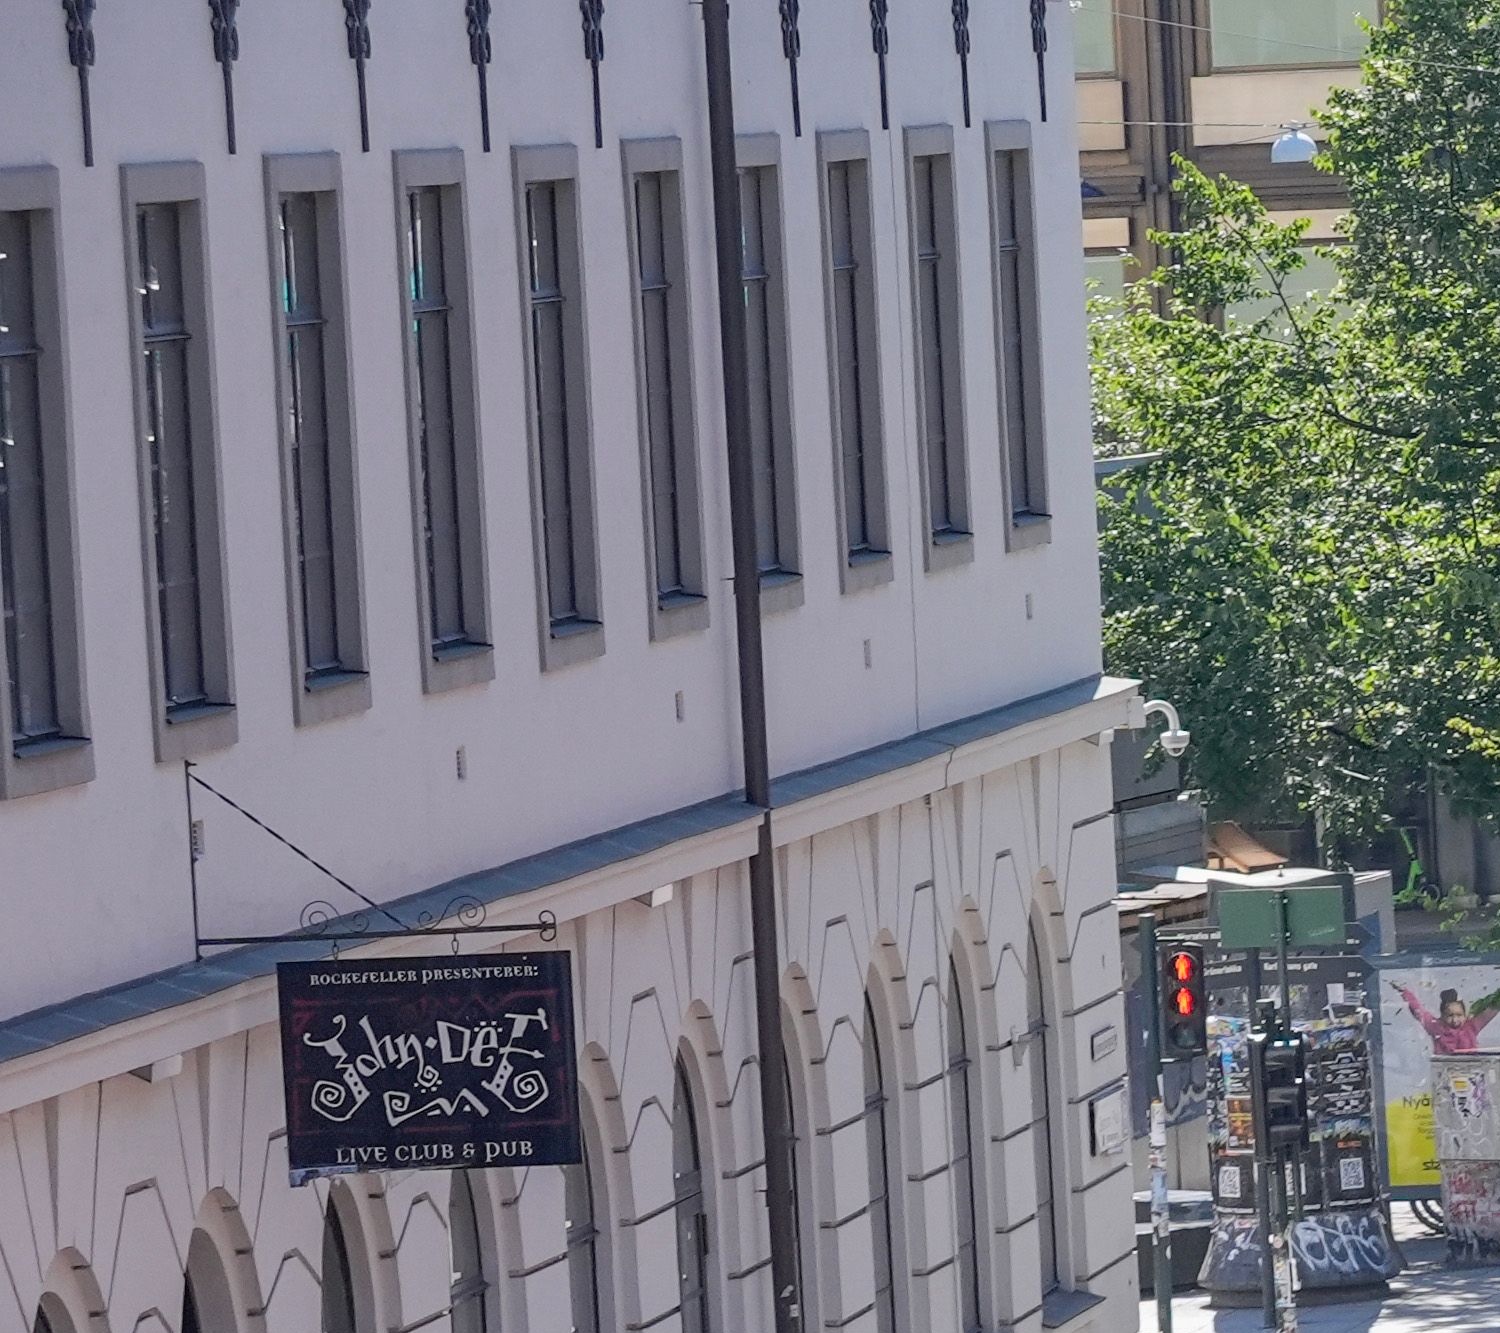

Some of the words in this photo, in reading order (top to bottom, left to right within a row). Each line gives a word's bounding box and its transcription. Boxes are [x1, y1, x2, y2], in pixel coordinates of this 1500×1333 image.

[310, 970, 417, 986] ROCKEFELLER
[422, 965, 539, 984] PRESENTERER:
[336, 1147, 387, 1164] LIVE
[395, 1144, 454, 1162] CLUB
[462, 1143, 475, 1158] &
[485, 1141, 534, 1163] PUB
